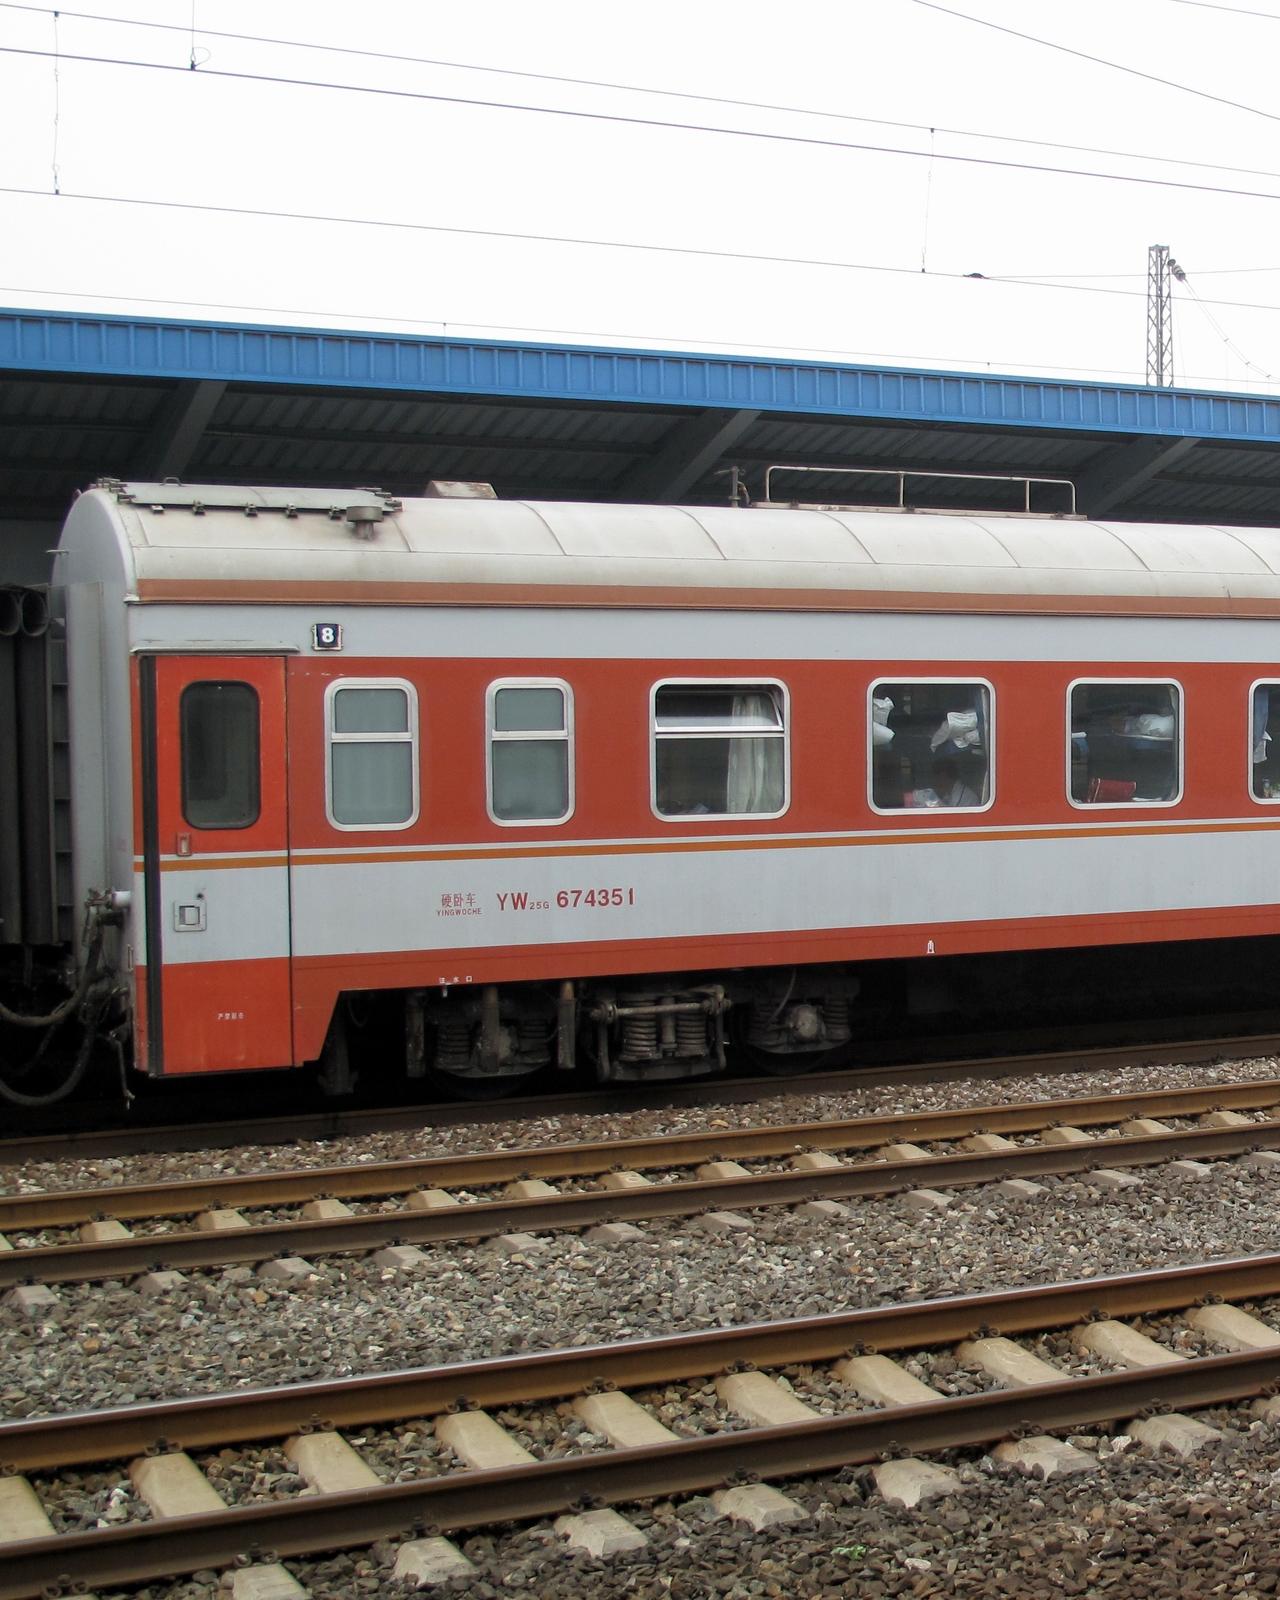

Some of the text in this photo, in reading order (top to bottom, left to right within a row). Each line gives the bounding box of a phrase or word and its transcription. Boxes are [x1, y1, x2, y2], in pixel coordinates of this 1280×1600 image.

[321, 627, 335, 643] 8
[441, 892, 477, 908] 硬卧车
[556, 887, 635, 908] 674351
[437, 907, 483, 917] YINGWOCHE
